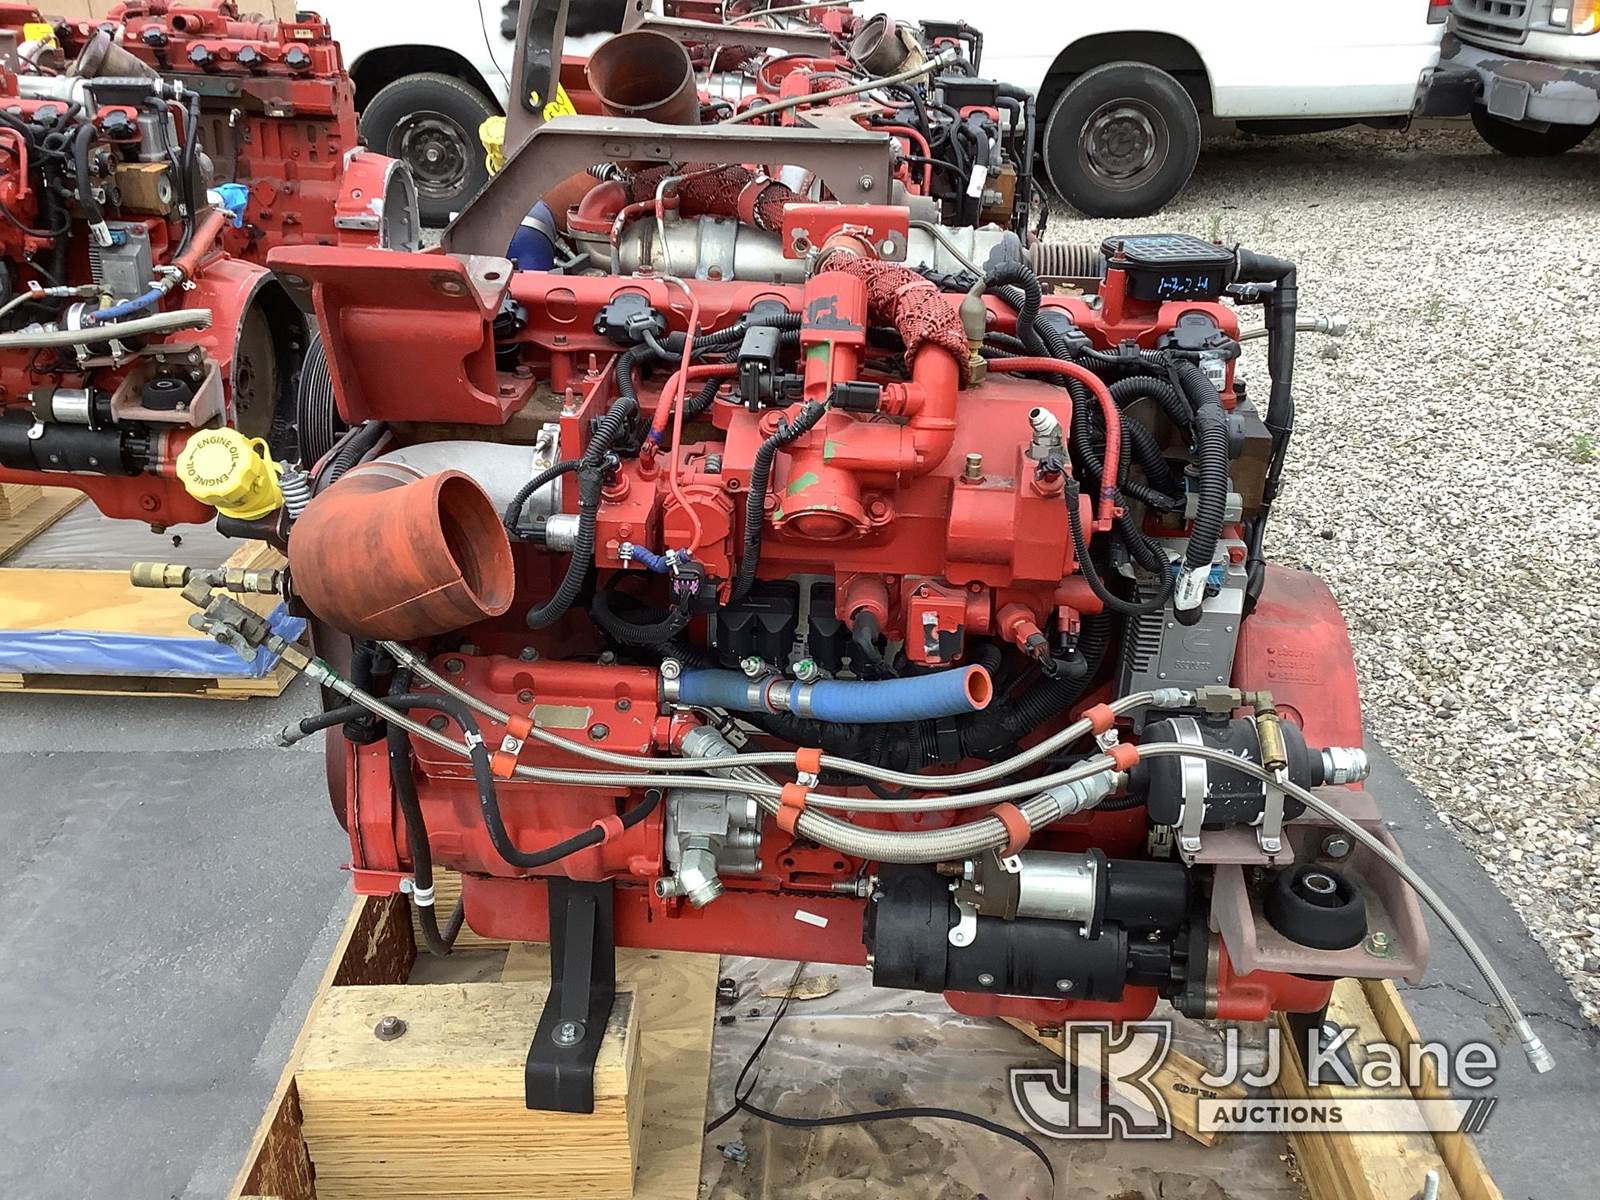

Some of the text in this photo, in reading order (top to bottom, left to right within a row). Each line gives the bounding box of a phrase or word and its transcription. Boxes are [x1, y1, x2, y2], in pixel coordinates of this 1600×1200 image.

[197, 436, 239, 461] ENGINE OIL
[186, 460, 229, 486] ENGINE OIL
